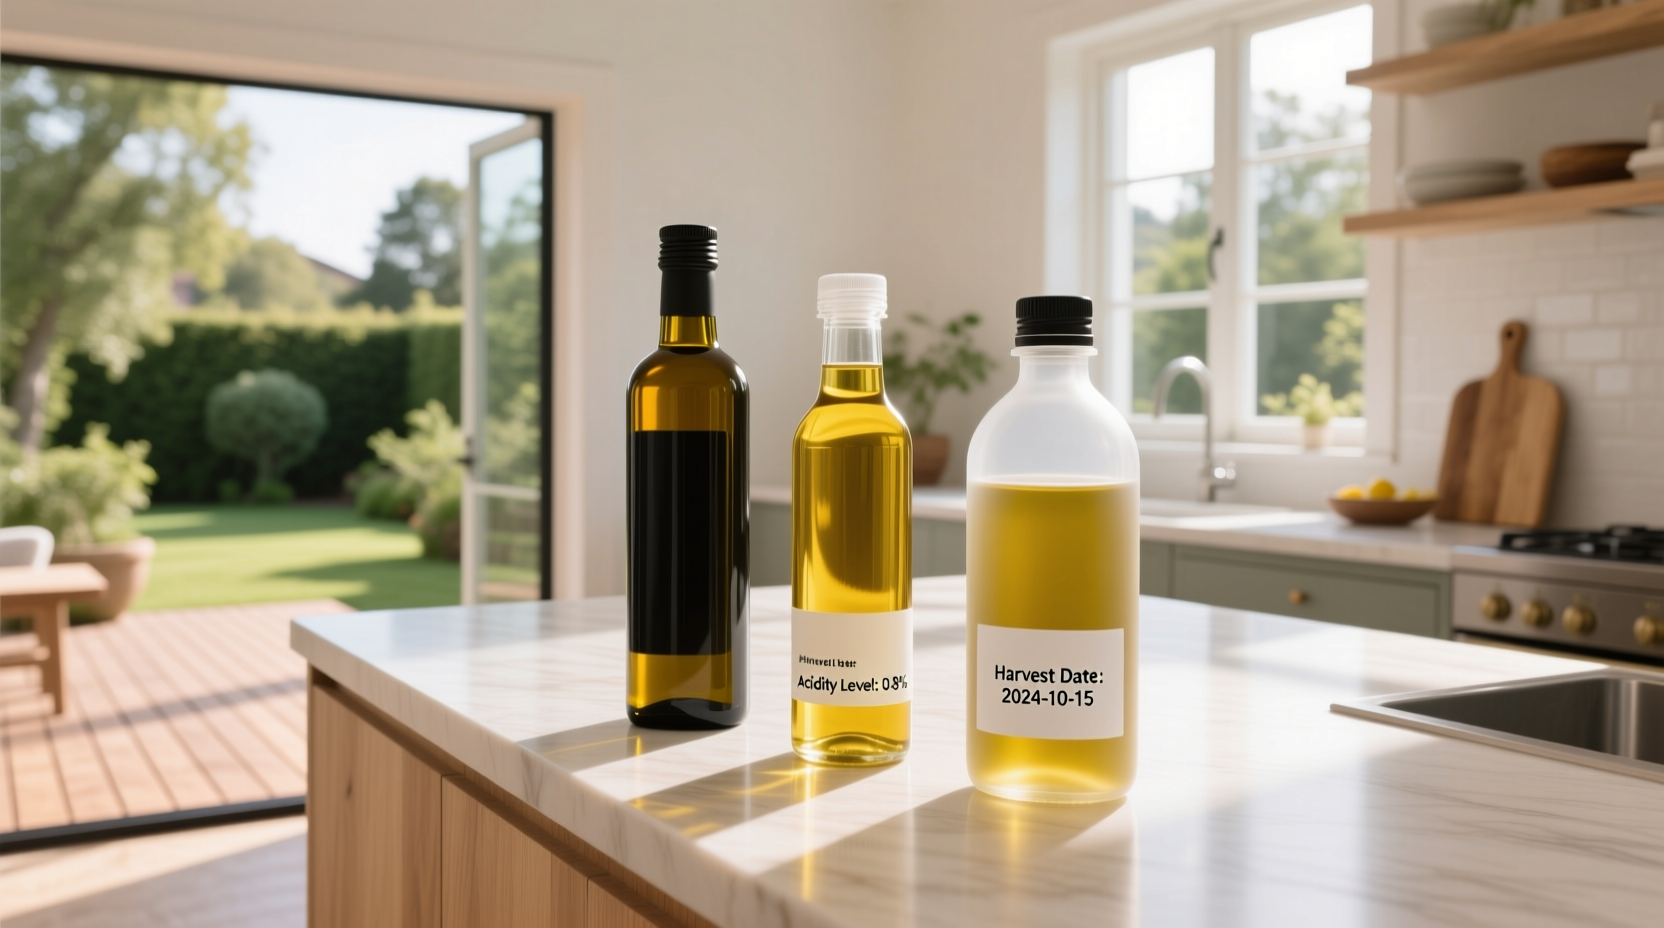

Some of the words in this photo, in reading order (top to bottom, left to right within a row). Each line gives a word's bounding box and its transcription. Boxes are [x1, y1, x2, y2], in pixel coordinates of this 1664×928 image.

[994, 664, 1056, 683] Harvest
[1060, 667, 1104, 684] Date:
[797, 675, 838, 695] Acidity
[840, 677, 879, 692] Level:
[1001, 687, 1094, 707] 2024-10-15
